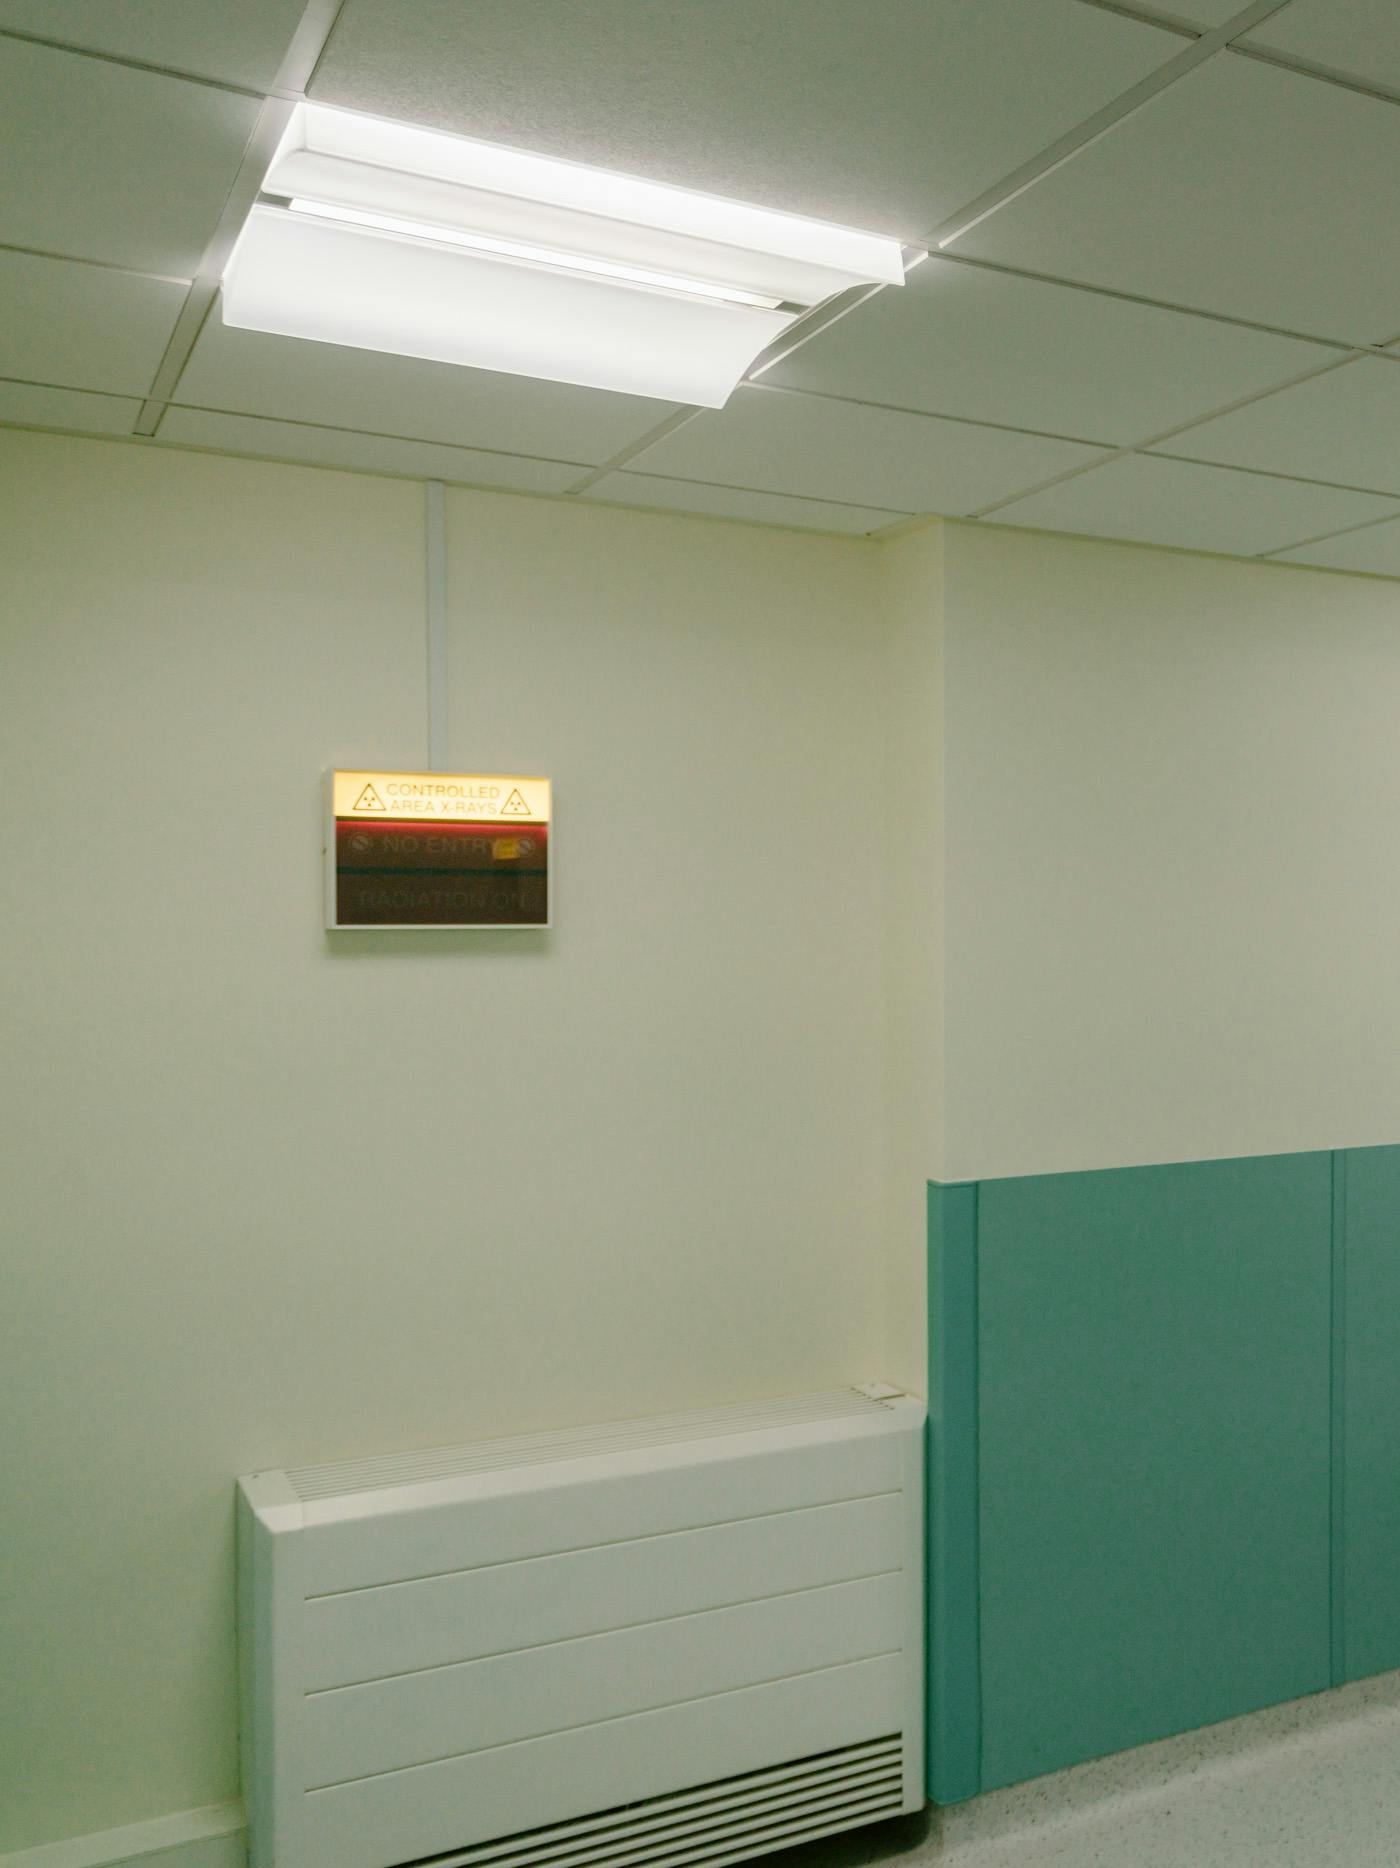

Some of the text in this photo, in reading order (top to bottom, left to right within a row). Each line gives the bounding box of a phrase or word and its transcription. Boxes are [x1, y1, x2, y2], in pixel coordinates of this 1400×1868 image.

[386, 783, 500, 799] CONTROLLED
[391, 800, 497, 815] AREA X-RAYS
[384, 835, 503, 856] NO ENTR
